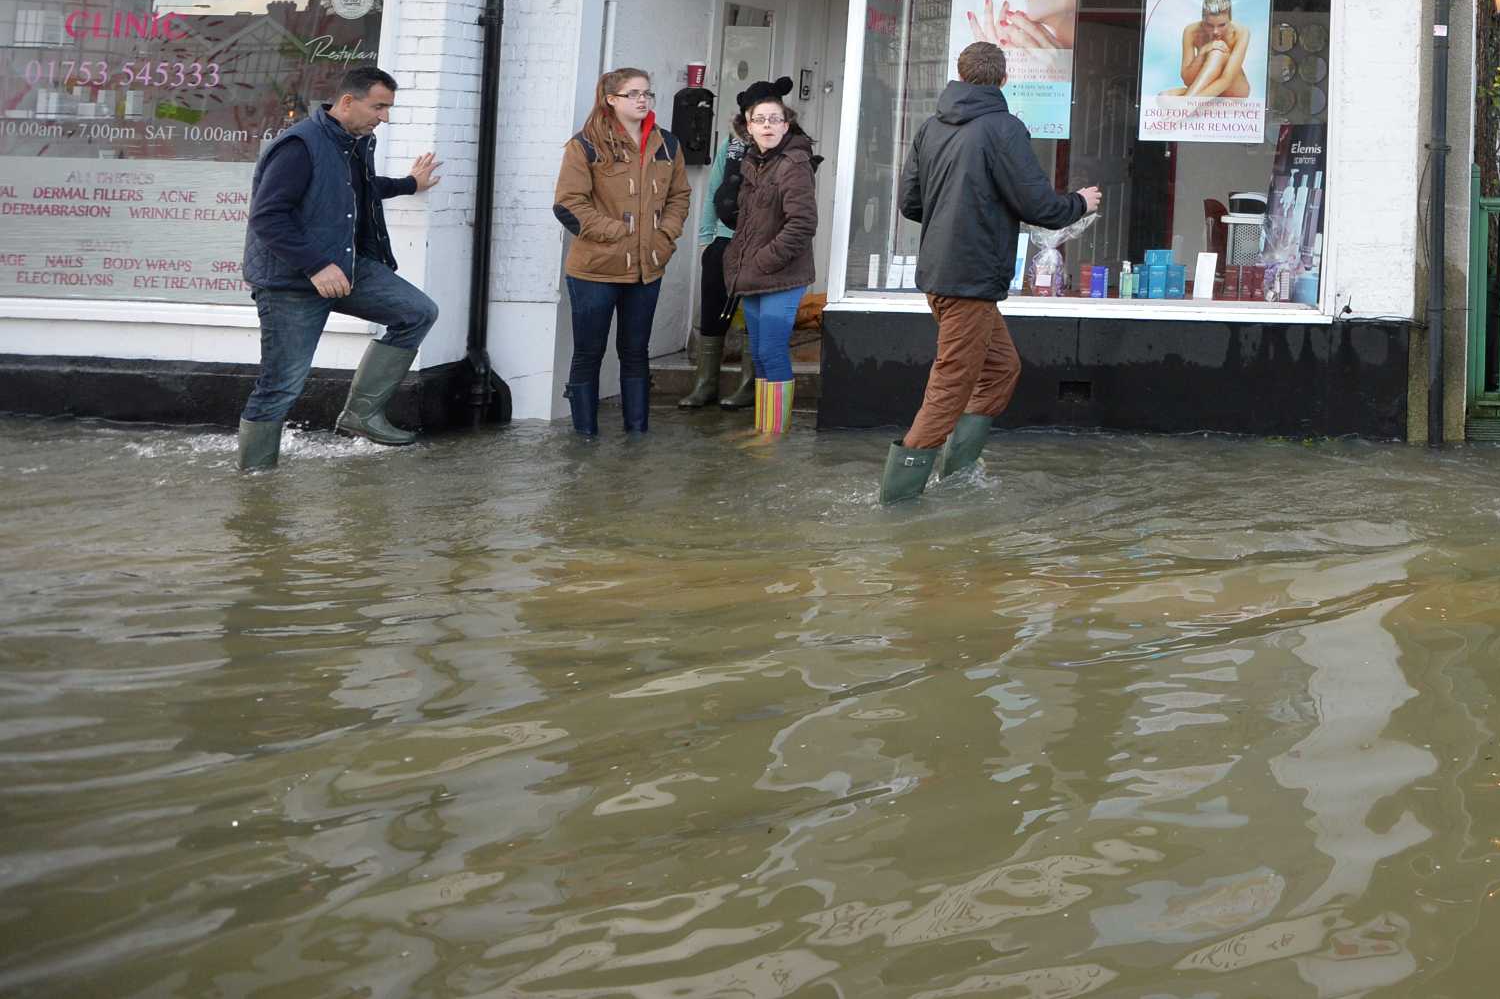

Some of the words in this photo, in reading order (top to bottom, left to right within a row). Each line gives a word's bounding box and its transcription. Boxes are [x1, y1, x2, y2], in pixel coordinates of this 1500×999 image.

[65, 10, 194, 40] CLINIC
[25, 60, 108, 86] 01753
[119, 62, 220, 88] 545333
[1167, 108, 1189, 119] FOR
[1204, 109, 1226, 119] FULL
[1234, 109, 1261, 120] FACE
[79, 123, 136, 141] 7.00pm
[145, 125, 177, 141] SAT
[184, 126, 248, 142] 10.00am
[1144, 121, 1177, 131] LASER
[1181, 122, 1204, 131] HAIR
[1208, 123, 1259, 133] REMOVAL
[1291, 141, 1322, 153] Elemis
[33, 186, 89, 201] DERMAL
[93, 188, 144, 202] FILLERS
[159, 190, 198, 203] ACNE
[216, 191, 249, 204] SKIN
[2, 202, 111, 218] DERMABRASION
[129, 206, 191, 220] WRINKLE
[45, 254, 84, 268] NAILS
[103, 257, 141, 270] BODY
[145, 259, 192, 273] WRAPS
[16, 271, 113, 287] ELECTROLYSIS
[133, 275, 159, 289] EYE
